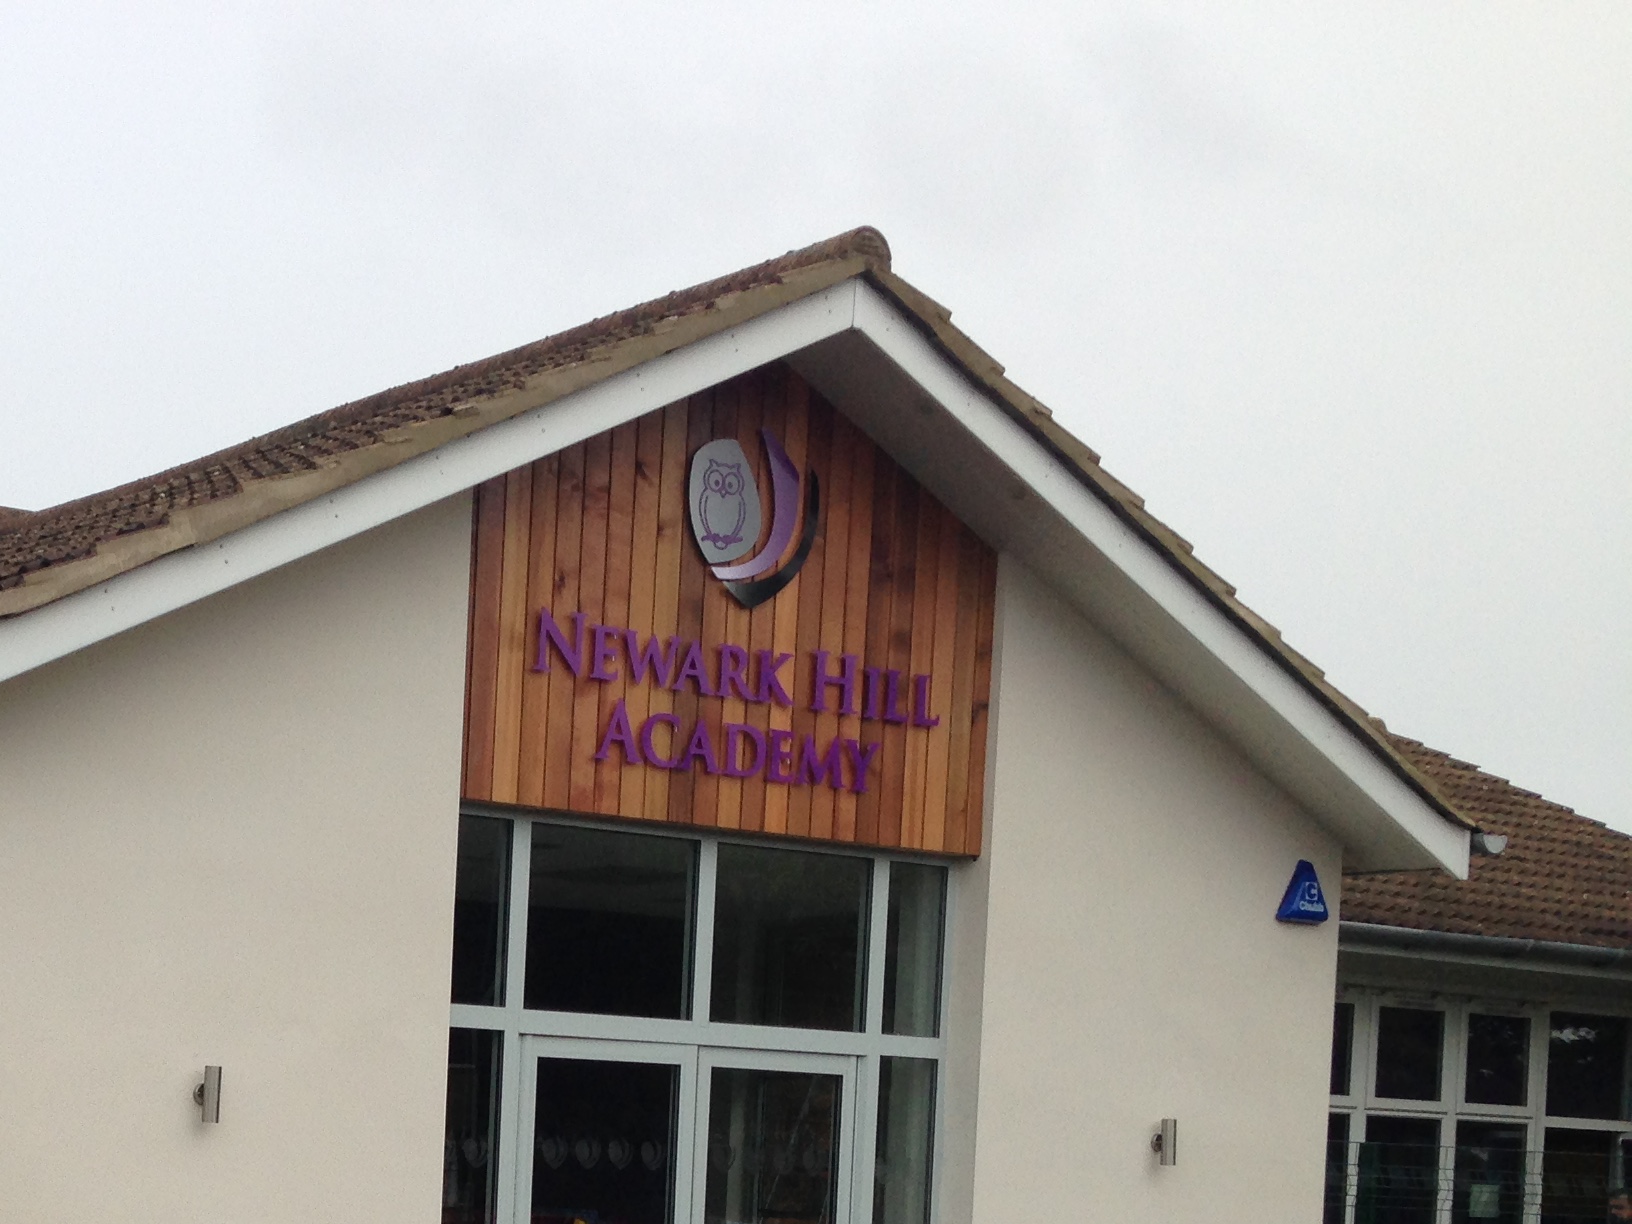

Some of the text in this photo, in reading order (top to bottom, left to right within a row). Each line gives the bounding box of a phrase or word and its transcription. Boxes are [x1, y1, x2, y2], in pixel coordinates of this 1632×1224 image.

[530, 606, 941, 728] NEWARK HILL
[593, 697, 881, 793] ACADEMY
